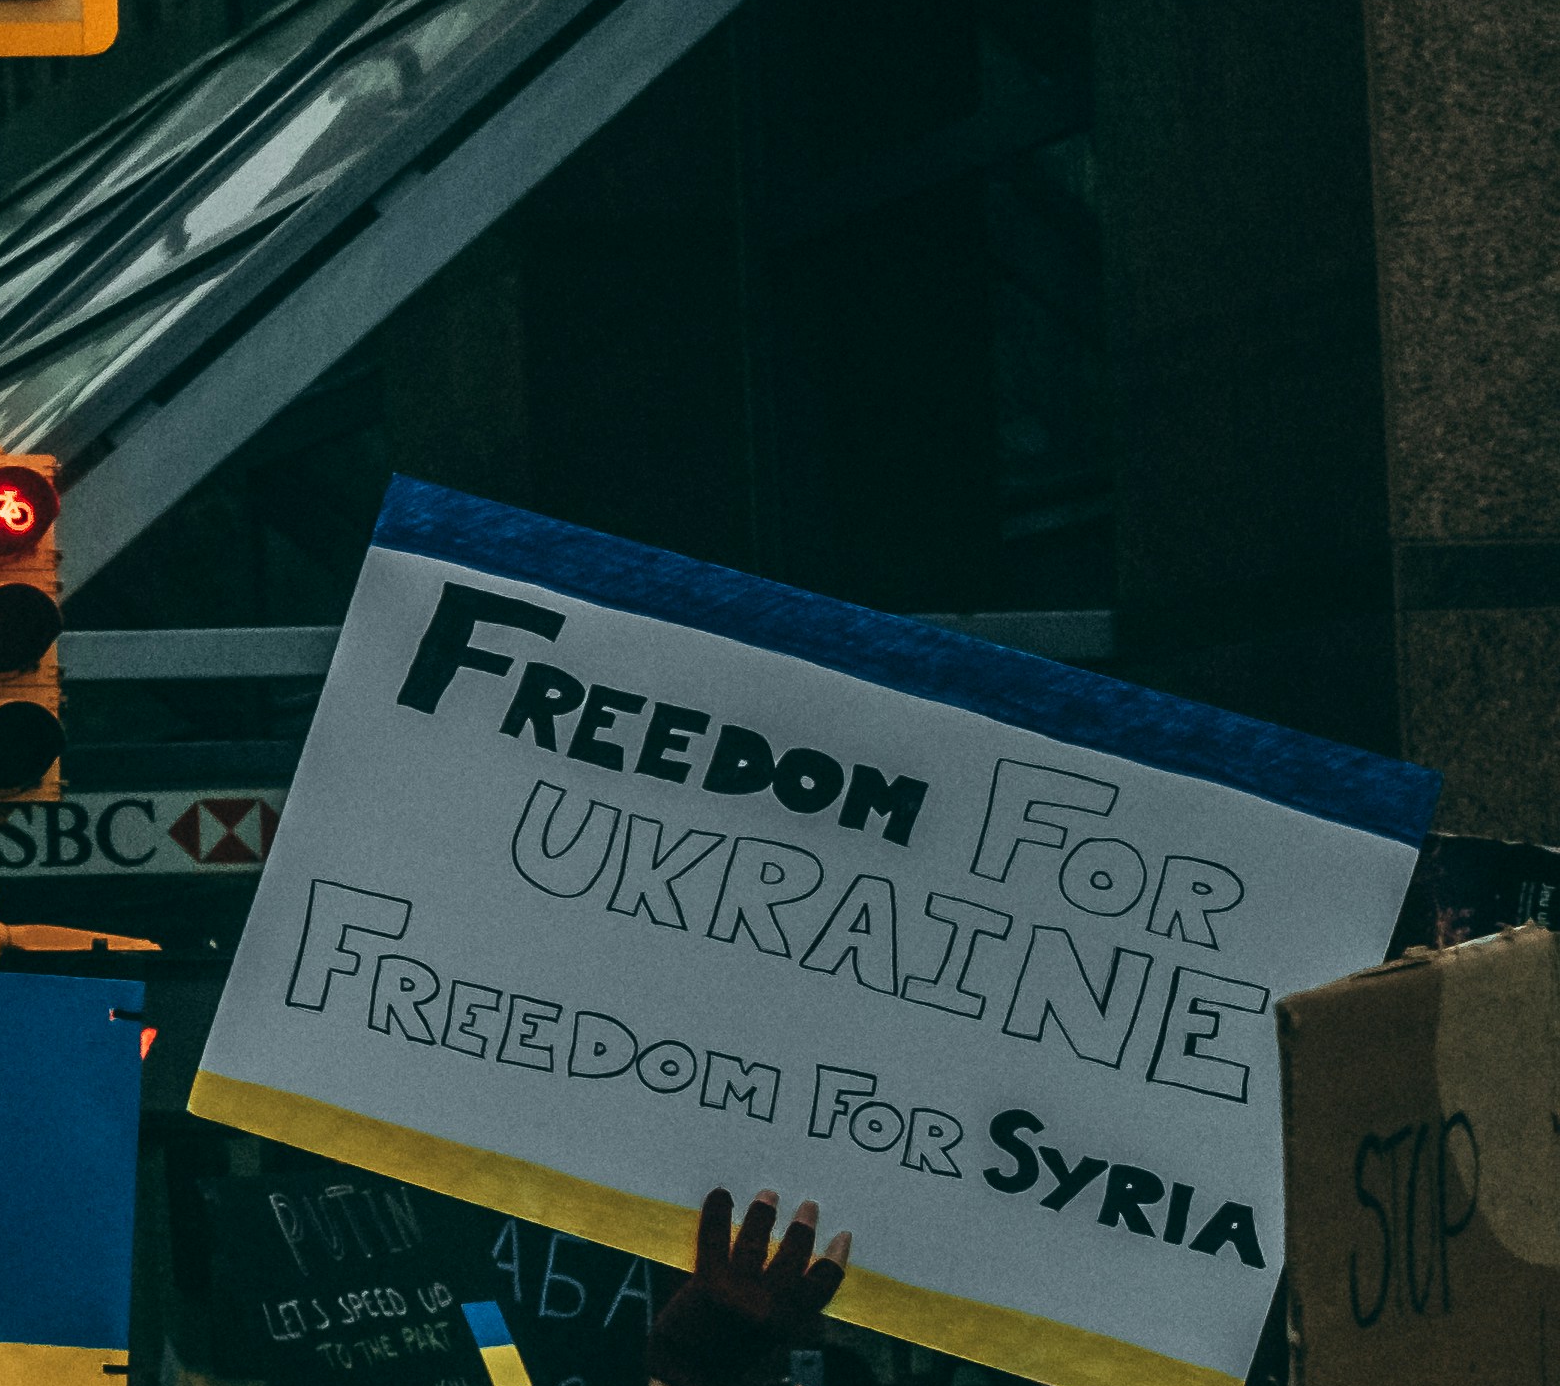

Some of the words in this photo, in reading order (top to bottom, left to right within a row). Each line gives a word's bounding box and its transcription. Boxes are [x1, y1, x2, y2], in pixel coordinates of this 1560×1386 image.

[396, 581, 928, 847] FREEDOM
[968, 757, 1245, 949] FOR
[511, 779, 1270, 1103] UKRAINE
[285, 879, 781, 1122] FREEDOM
[808, 1064, 963, 1179] FOR
[982, 1107, 1269, 1268] SYRIA
[267, 1182, 423, 1278] PUTIN
[336, 1286, 408, 1325] SPEED
[1348, 1111, 1480, 1329] STOP
[315, 1341, 354, 1371] TO
[354, 1333, 400, 1367] THE
[400, 1321, 451, 1356] PART
